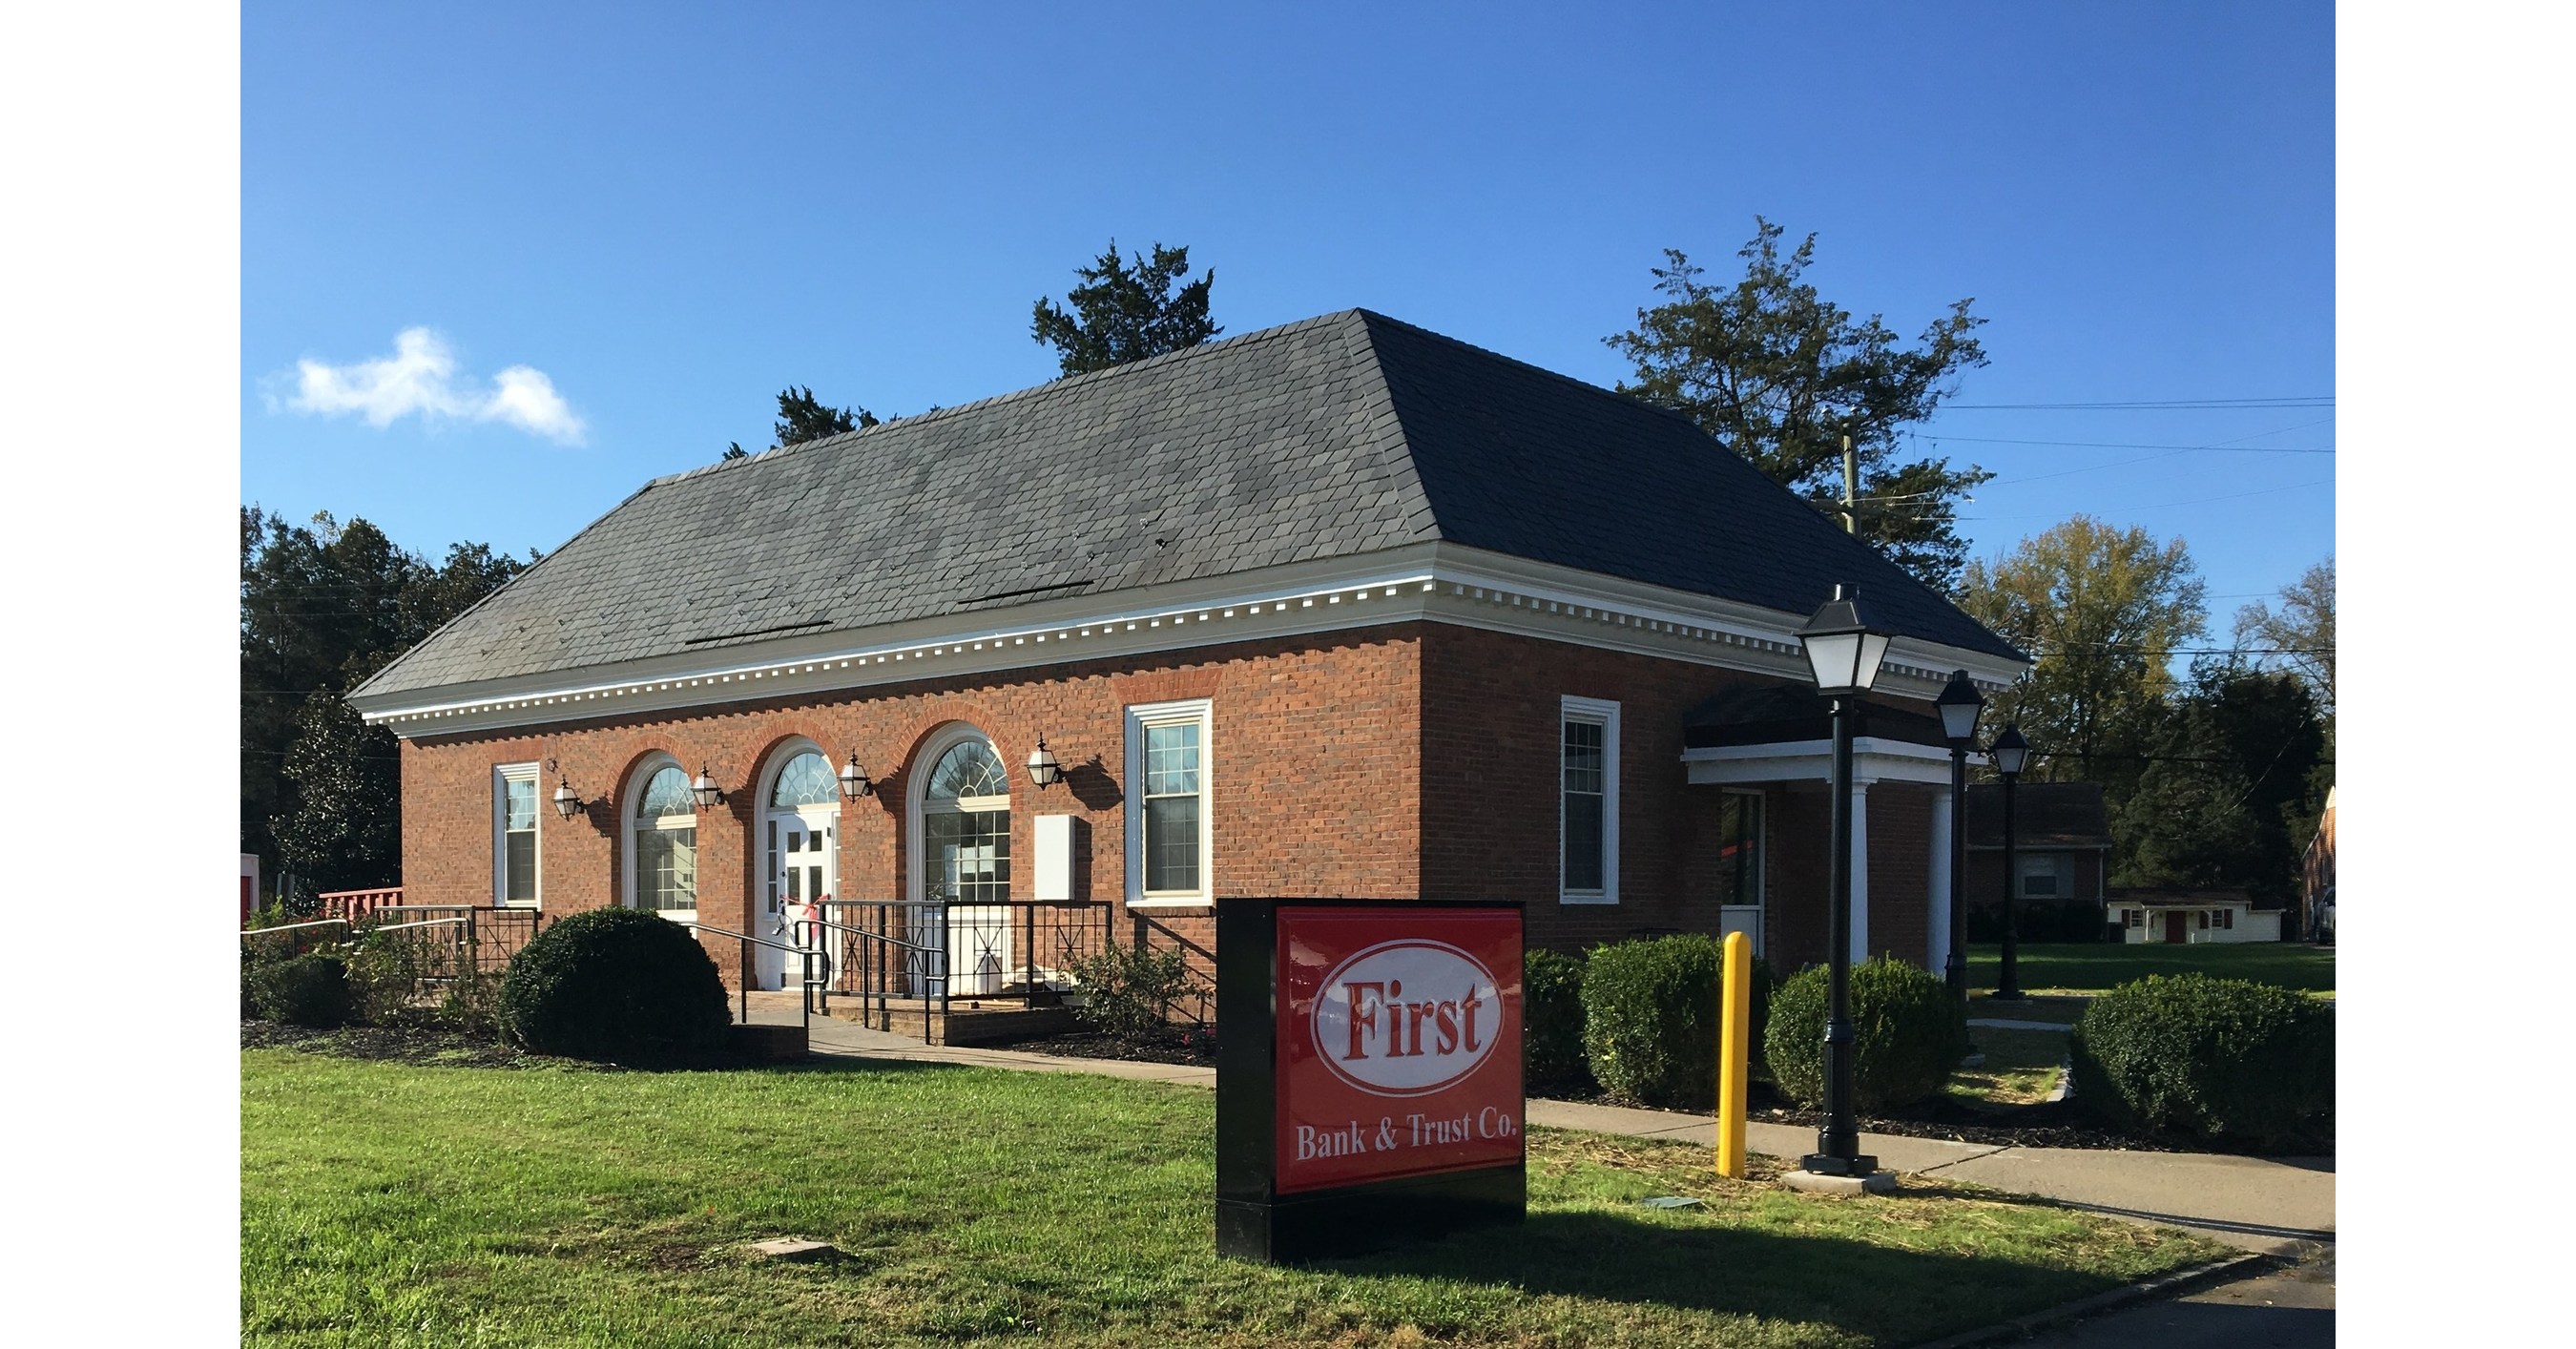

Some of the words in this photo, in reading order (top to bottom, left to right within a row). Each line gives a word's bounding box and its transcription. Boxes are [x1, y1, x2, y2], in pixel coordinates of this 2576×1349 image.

[1341, 979, 1482, 1062] First
[1296, 1120, 1366, 1161] Bank
[1374, 1116, 1398, 1152] &
[1406, 1111, 1471, 1148] Trust
[1479, 1106, 1517, 1139] Co.
